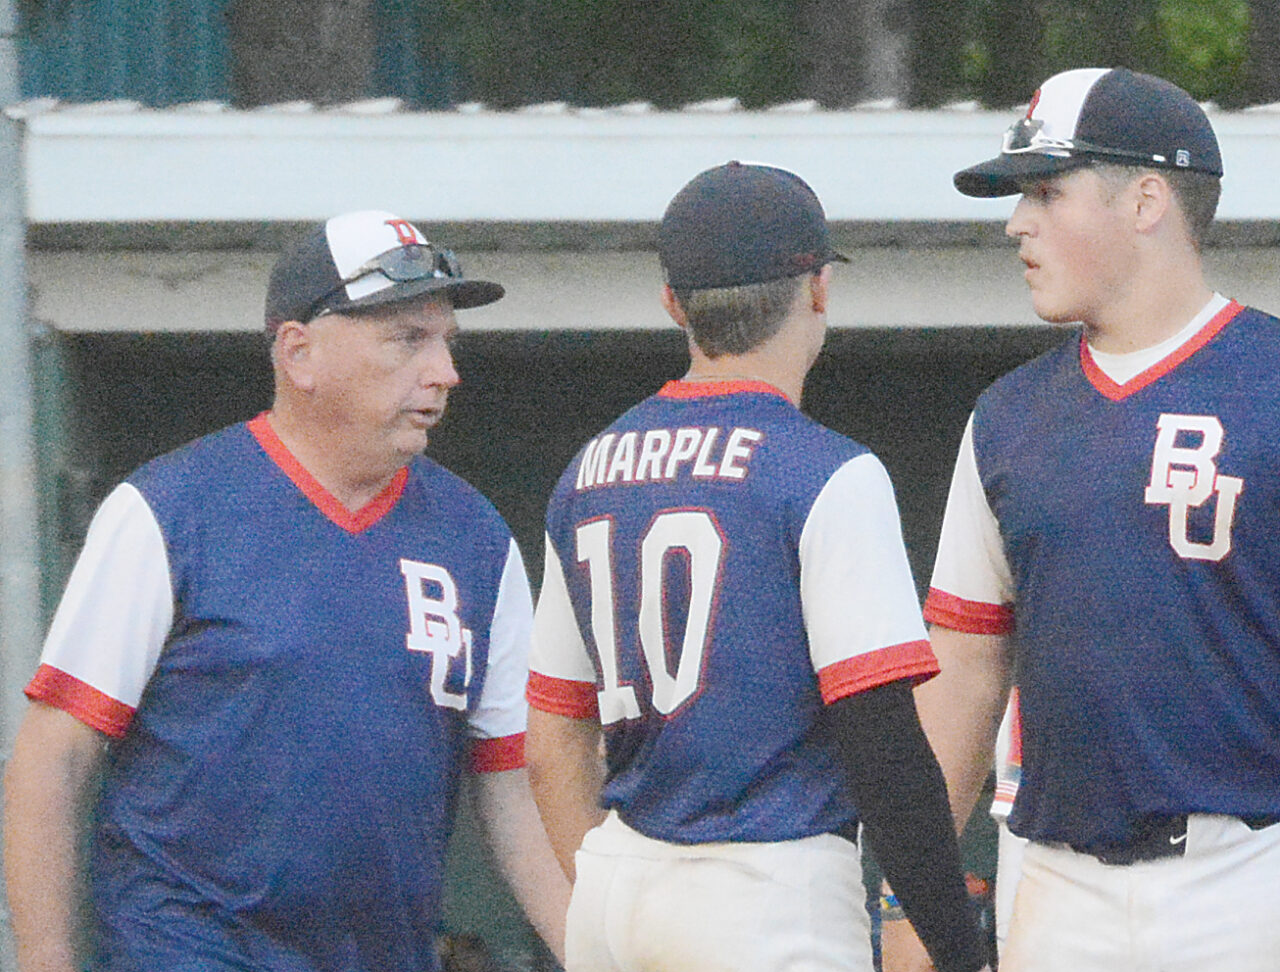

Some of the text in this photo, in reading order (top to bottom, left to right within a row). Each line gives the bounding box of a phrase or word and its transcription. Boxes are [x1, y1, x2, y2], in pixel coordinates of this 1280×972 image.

[574, 426, 764, 491] MARPLE
[1143, 412, 1245, 562] BU
[575, 508, 728, 727] 10
